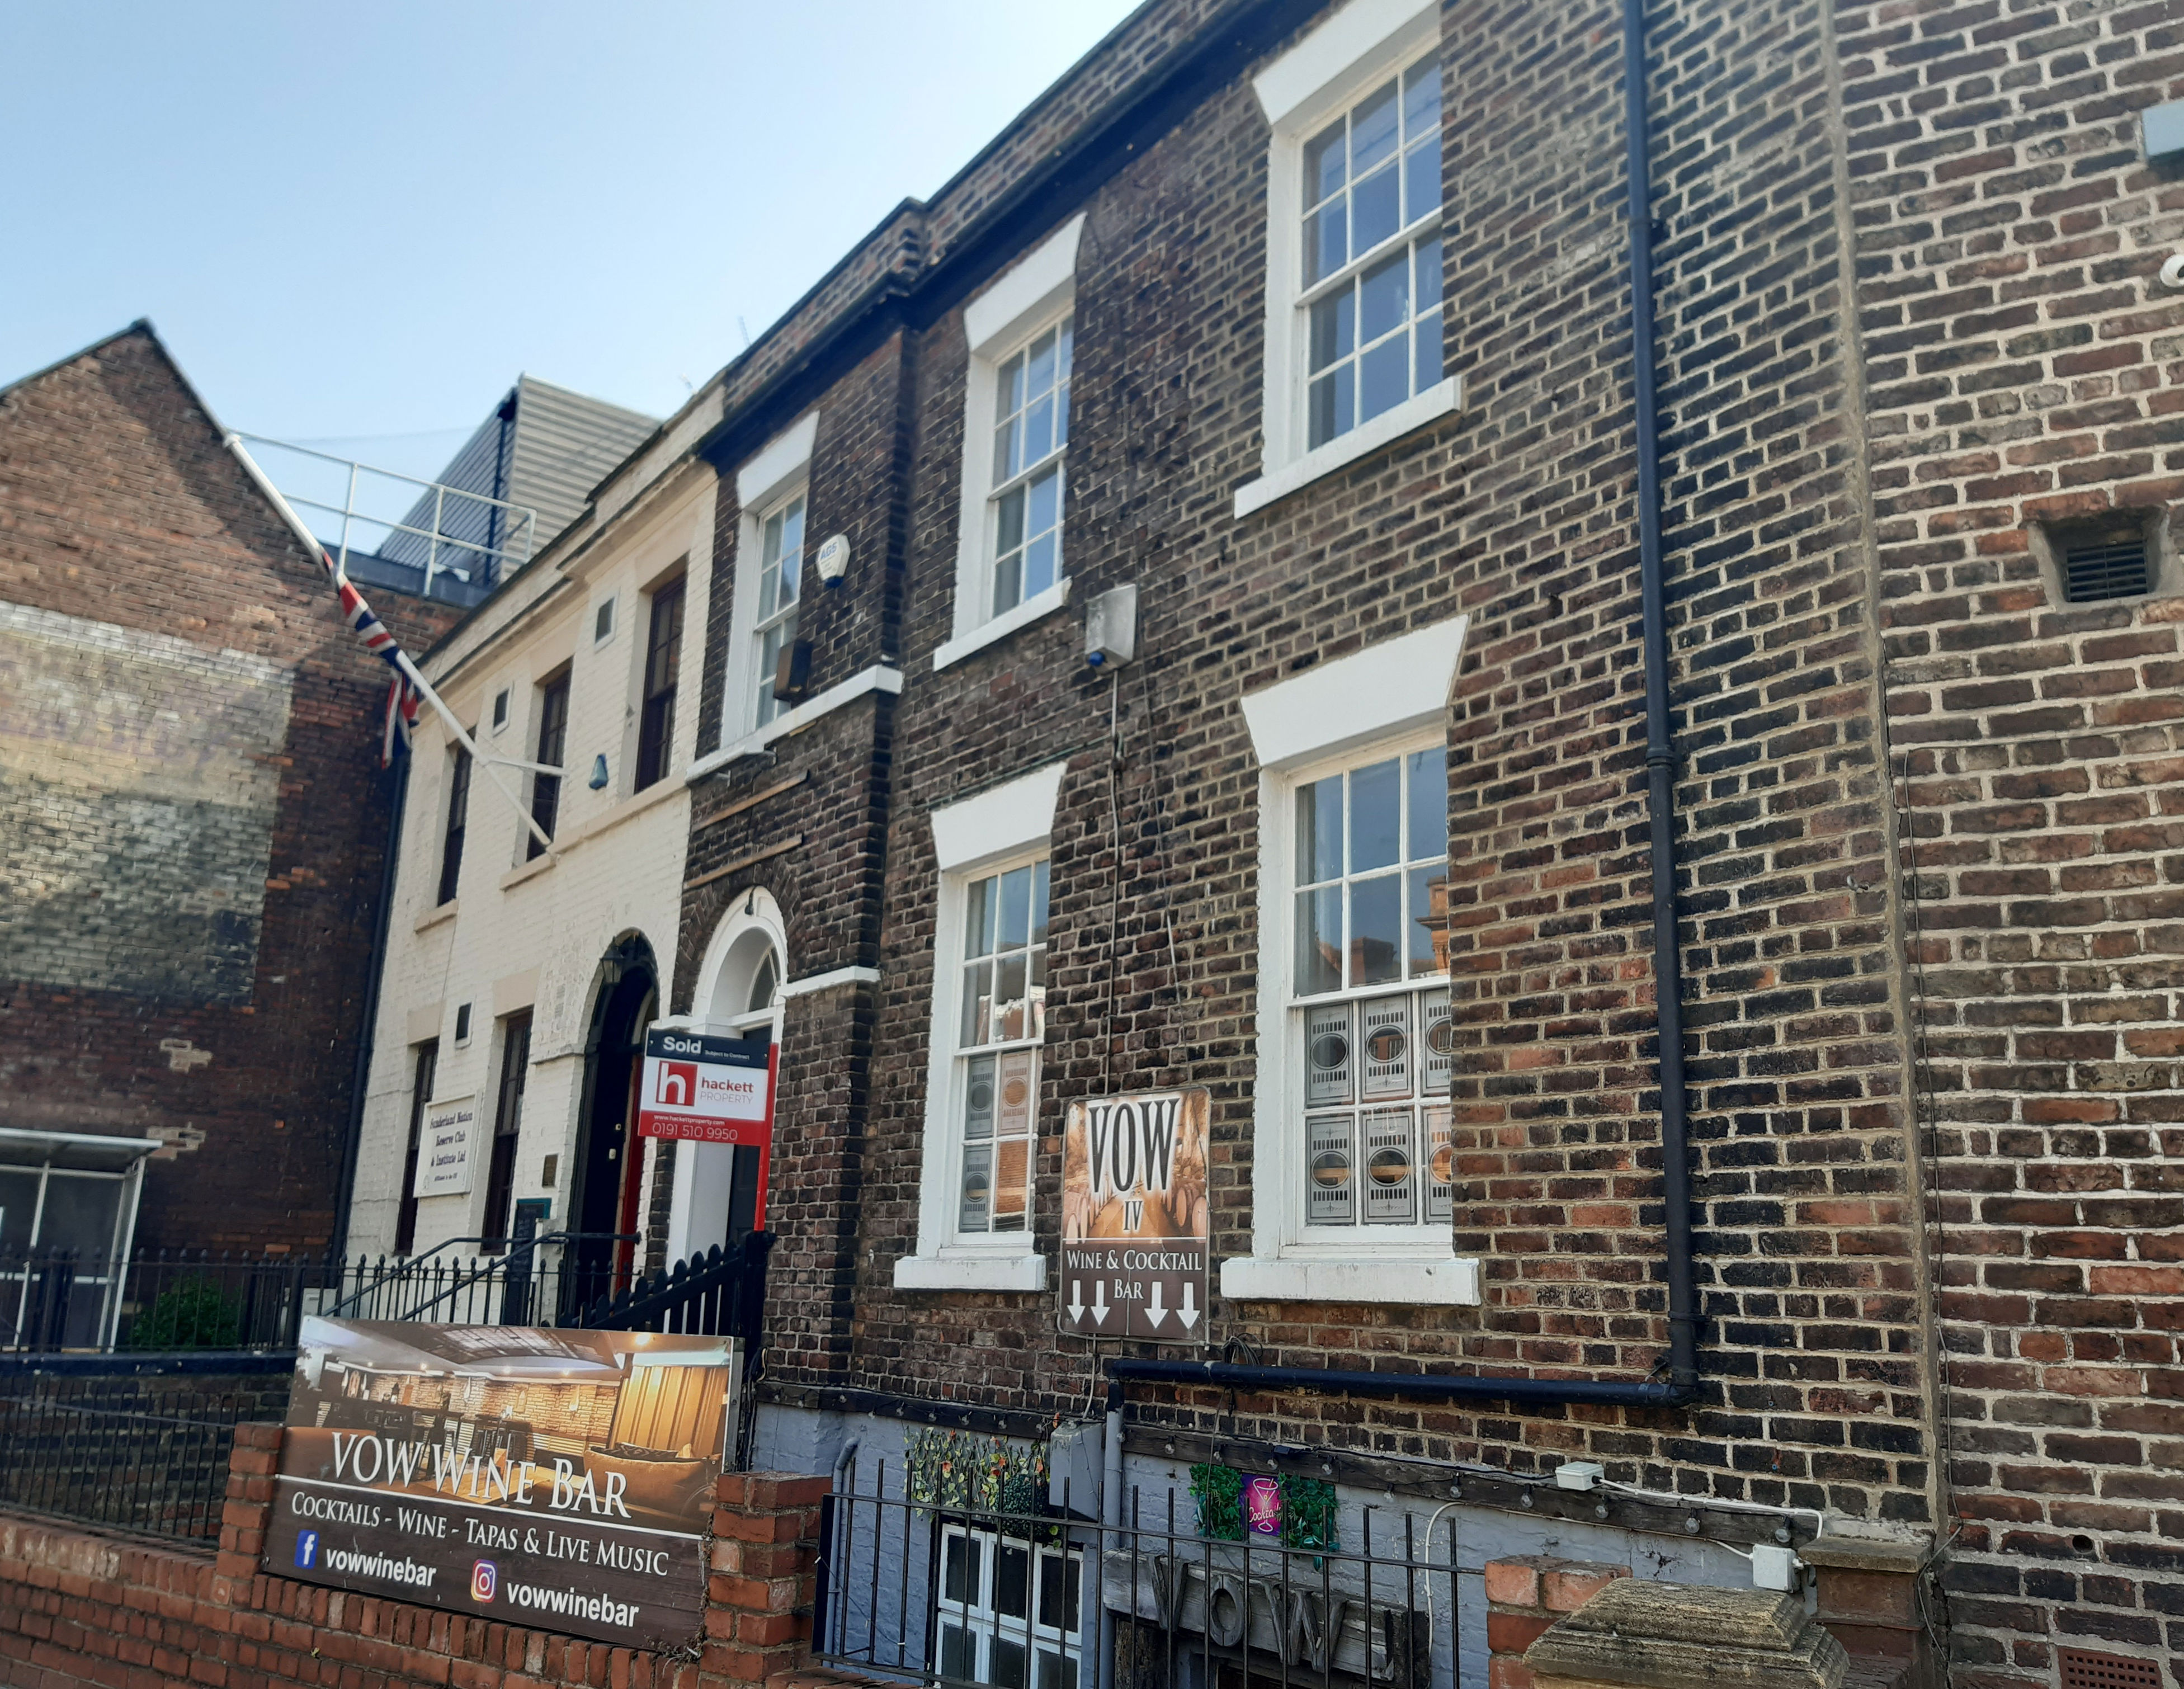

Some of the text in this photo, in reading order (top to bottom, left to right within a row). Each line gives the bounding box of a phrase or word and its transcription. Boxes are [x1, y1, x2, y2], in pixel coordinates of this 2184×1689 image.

[663, 1036, 702, 1054] Sold
[701, 1077, 754, 1093] hackett
[700, 1091, 753, 1105] PROPERTY
[652, 1122, 738, 1140] 0191 510 9950
[654, 1115, 725, 1126] www.hackettproperty.com
[455, 1130, 466, 1143] Club
[1088, 1097, 1181, 1193] VOW
[1123, 1200, 1143, 1231] IV
[1106, 1249, 1120, 1270] &
[332, 1431, 424, 1488] VOW
[1249, 1502, 1281, 1522] Cocktal
[523, 1527, 541, 1555] &
[326, 1548, 437, 1587] vowwinebar
[507, 1582, 639, 1627] vowwinebar
[1147, 1555, 1348, 1673] VOW
